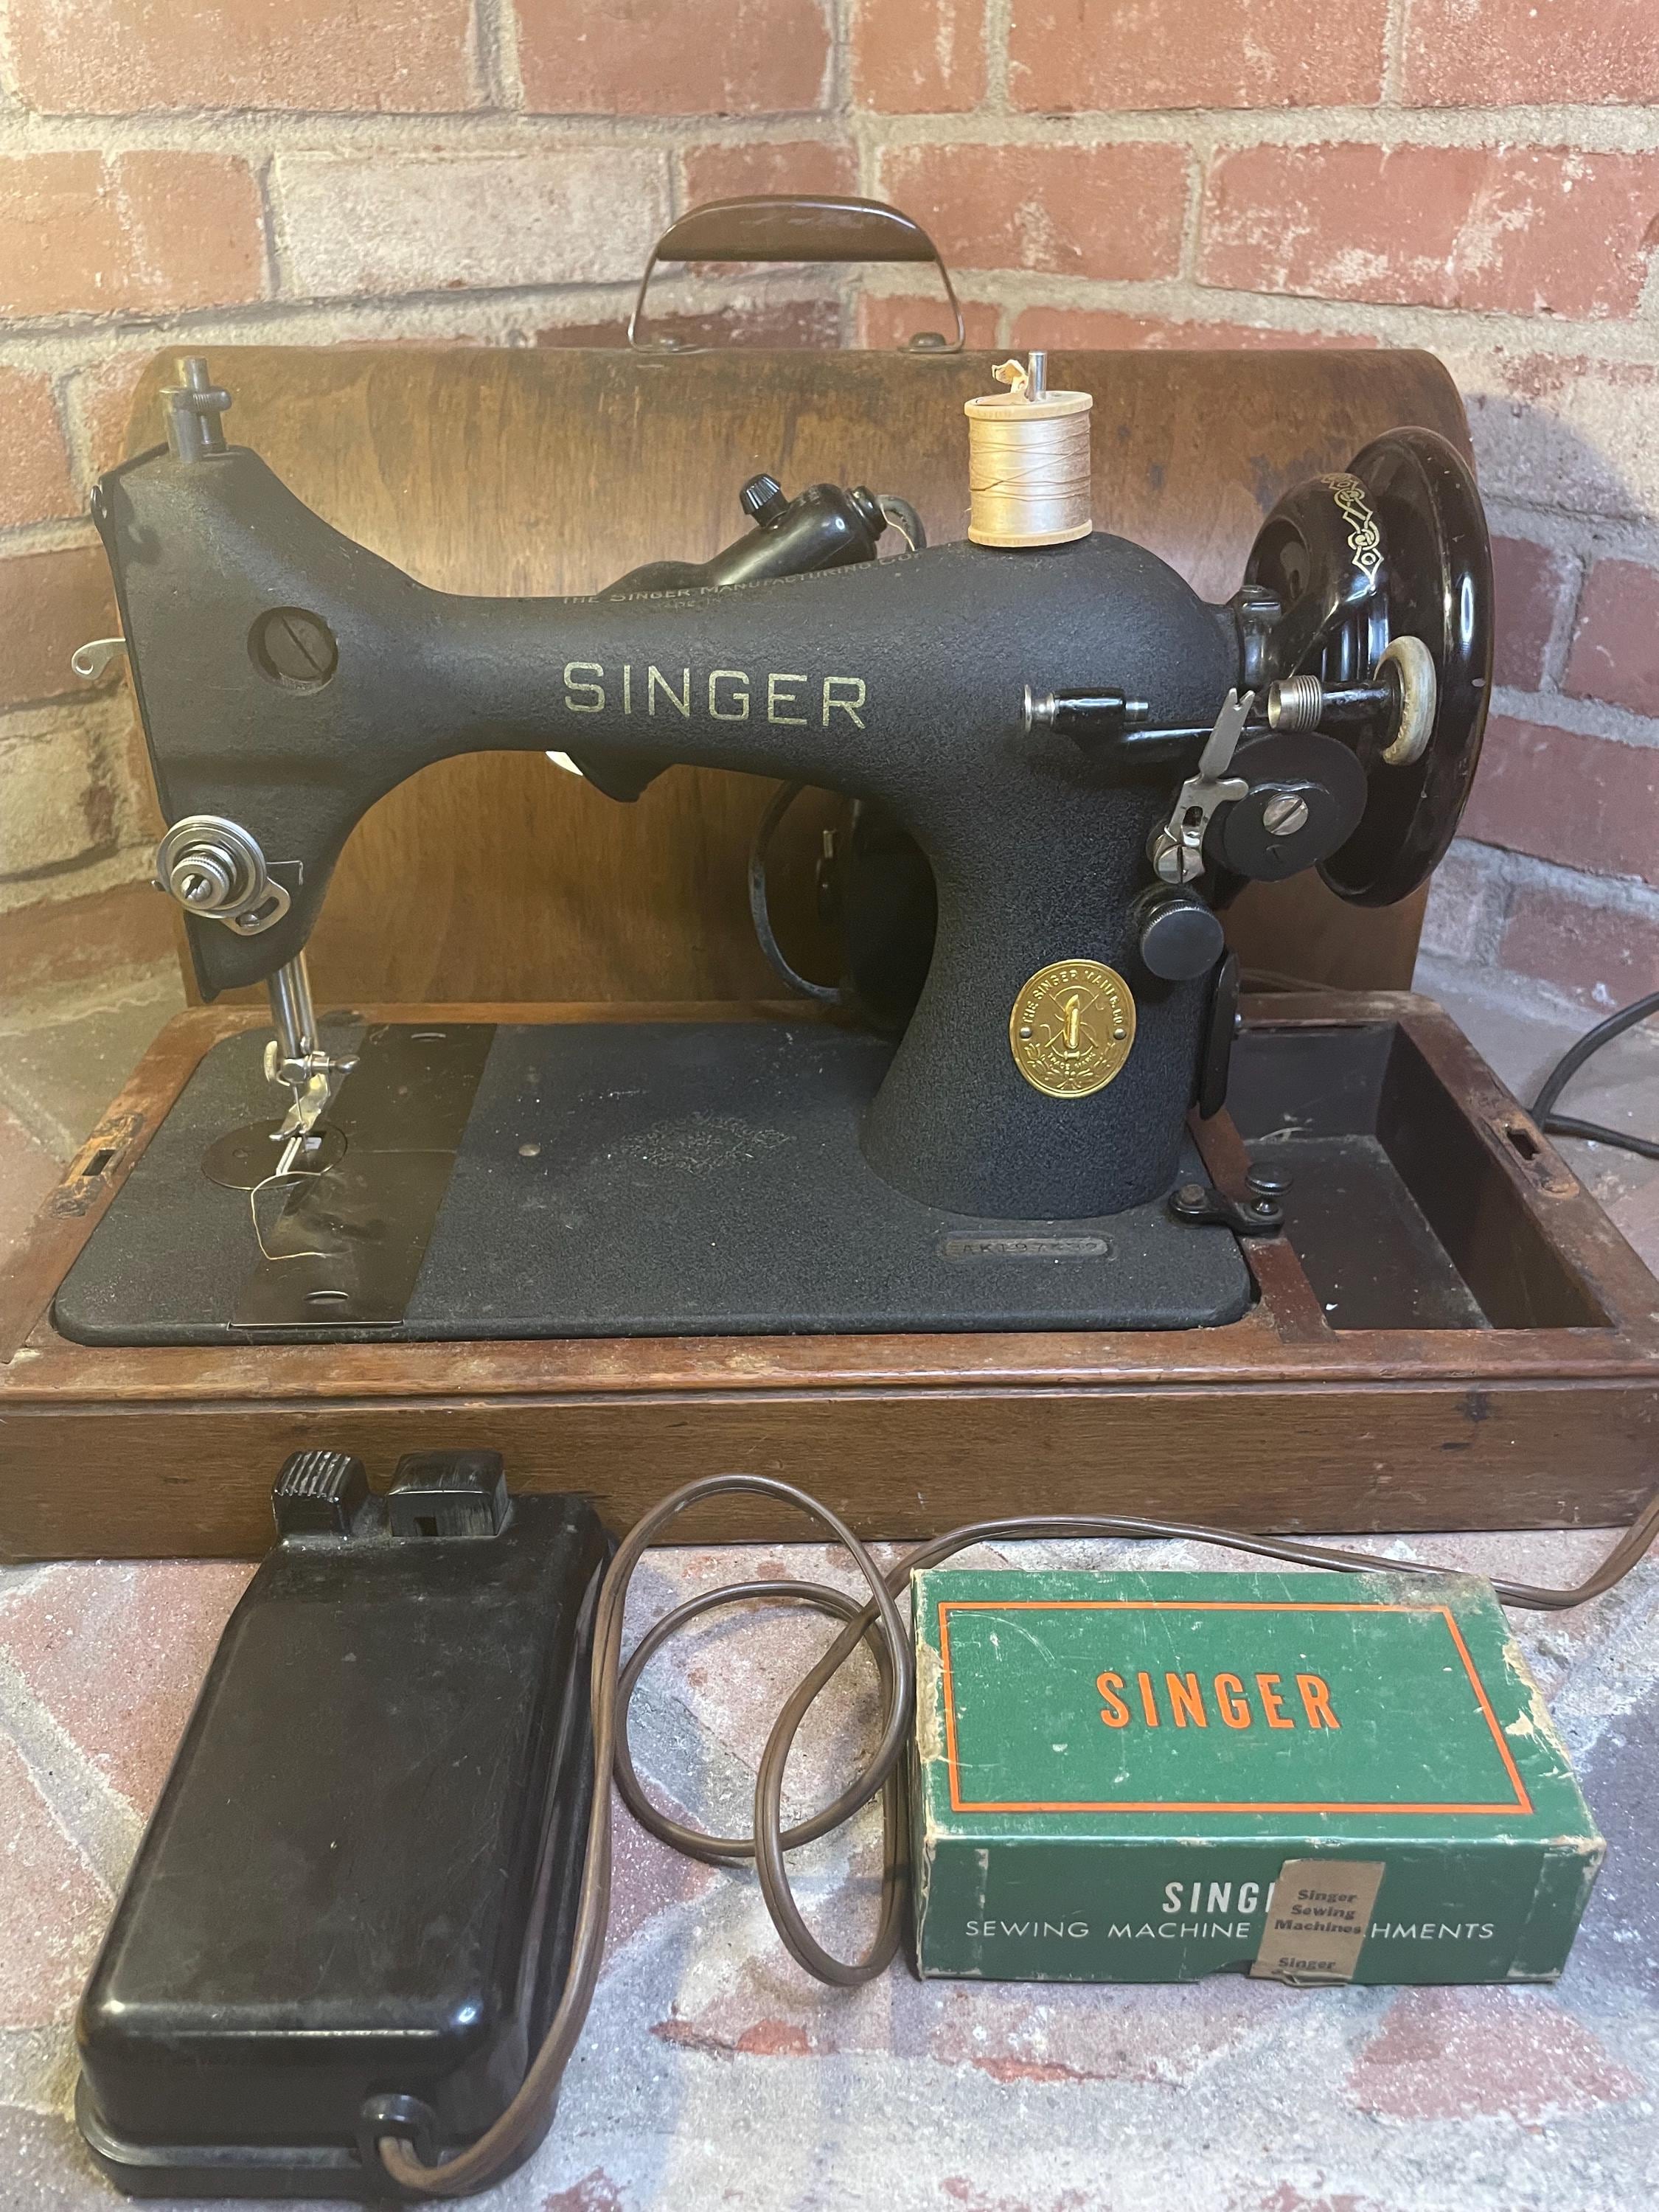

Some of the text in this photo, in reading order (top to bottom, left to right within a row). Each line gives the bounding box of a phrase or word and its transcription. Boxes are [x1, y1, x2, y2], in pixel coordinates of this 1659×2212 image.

[609, 589, 691, 602] SINGER
[563, 661, 867, 729] SINGER
[1022, 1001, 1039, 1023] THE
[1032, 969, 1078, 1000] SINGER
[1096, 1671, 1341, 1731] SINGER
[1163, 1881, 1276, 1913] SING
[1298, 1888, 1357, 1903] Singer
[1290, 1904, 1356, 1920] Sewing
[965, 1920, 1495, 1941] SEWING MACHINE HMENTS
[1274, 1919, 1361, 1934] Machines
[1278, 1957, 1336, 1969] Singer
